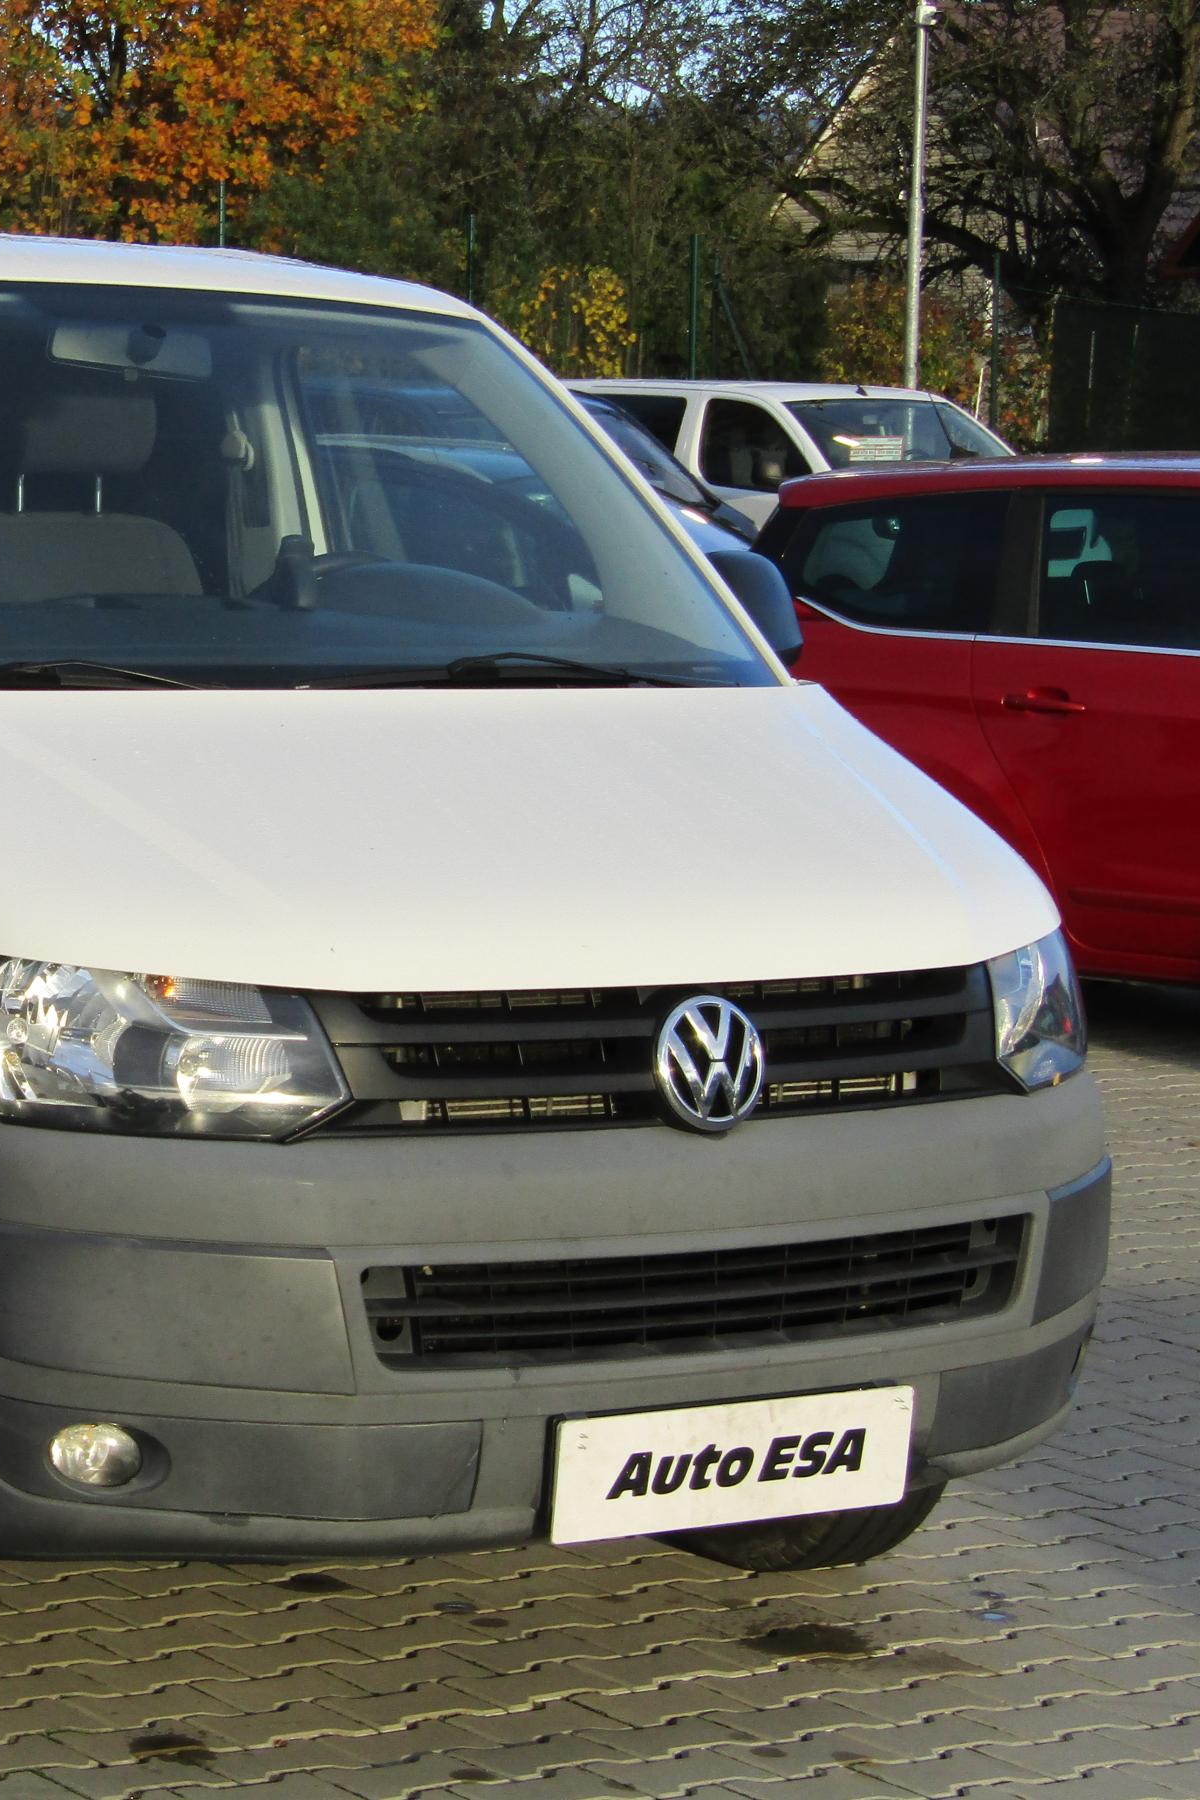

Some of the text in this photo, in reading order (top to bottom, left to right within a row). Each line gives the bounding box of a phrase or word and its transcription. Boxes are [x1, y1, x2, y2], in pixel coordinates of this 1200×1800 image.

[660, 999, 759, 1126] VW
[605, 1428, 866, 1500] Auto ESA
